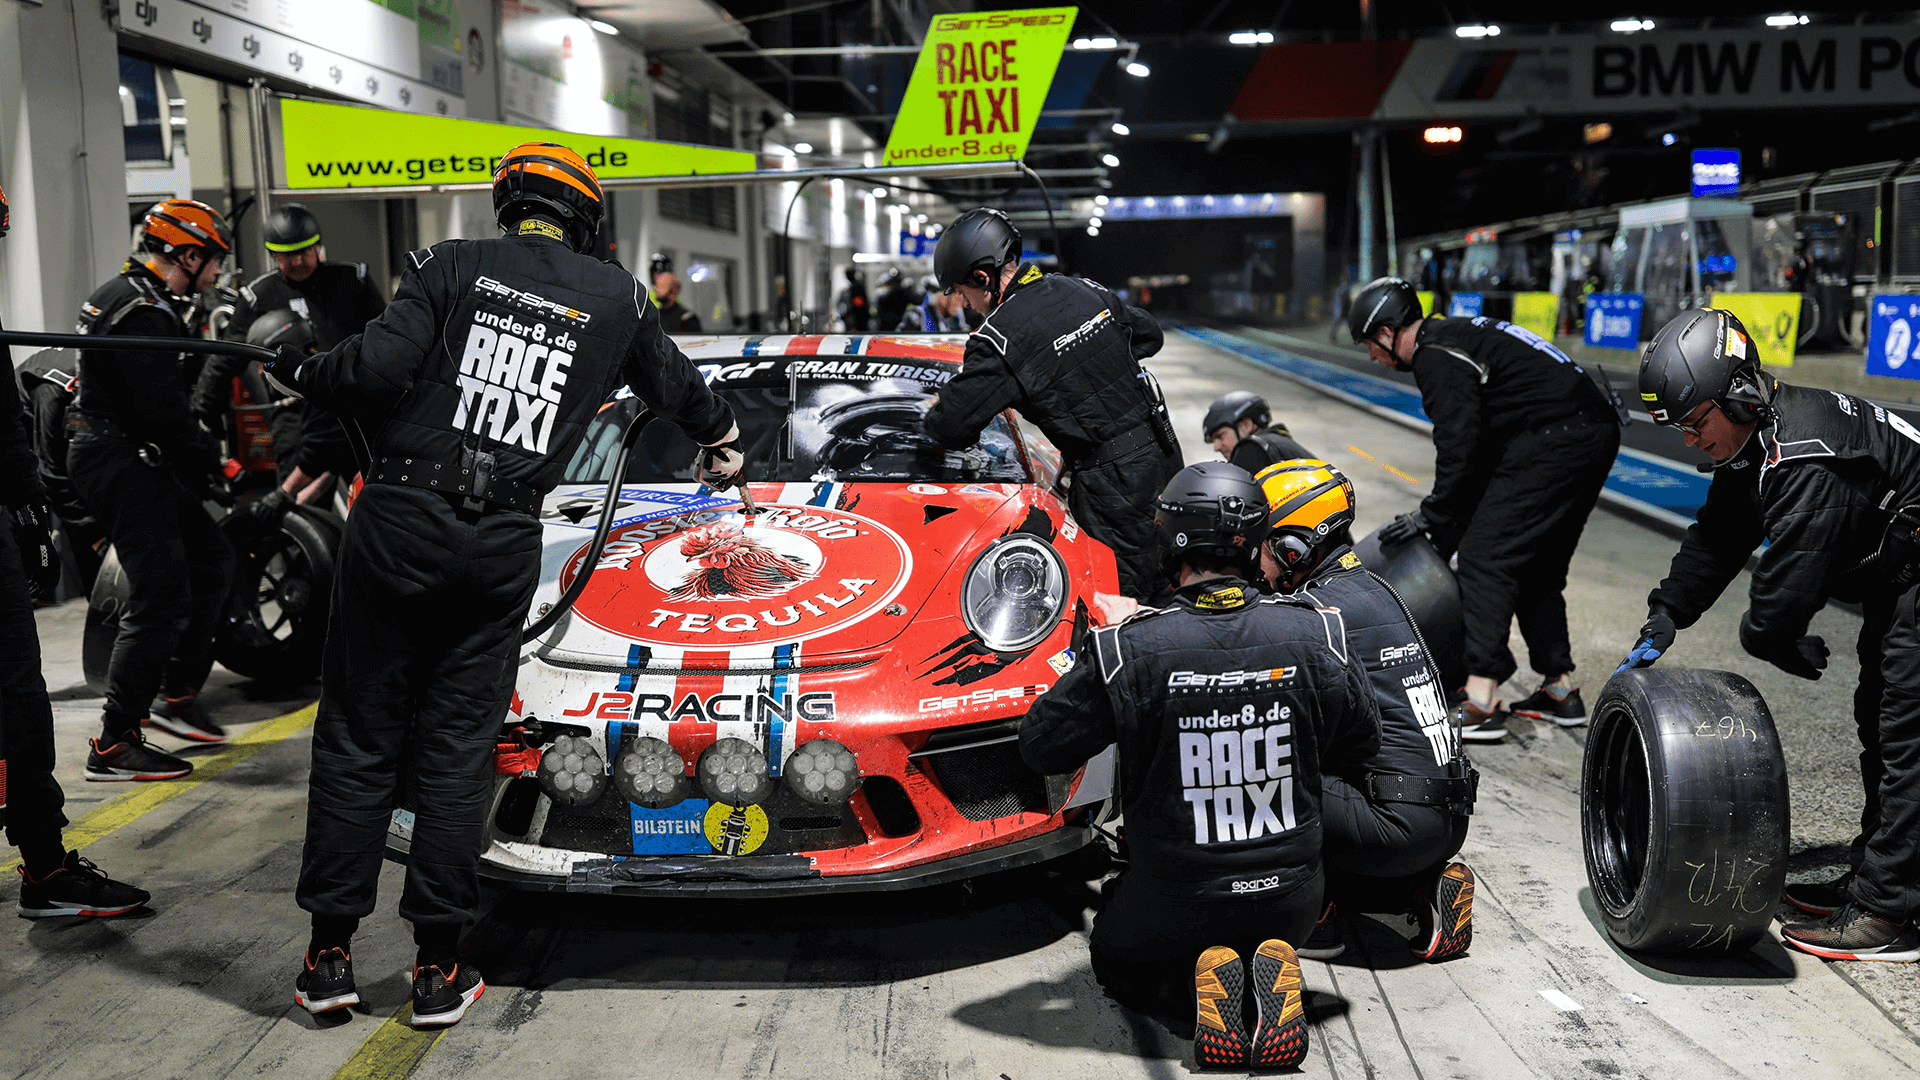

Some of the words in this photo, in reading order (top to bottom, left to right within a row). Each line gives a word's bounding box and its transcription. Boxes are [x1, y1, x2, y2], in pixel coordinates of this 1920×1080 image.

[936, 39, 1018, 85] RACE
[1592, 41, 1761, 98] BMW
[1781, 39, 1837, 92] M
[937, 87, 1020, 136] TAXI
[890, 140, 1017, 159] under8.de
[474, 310, 577, 351] under8.de
[459, 323, 574, 404] RACE
[785, 361, 860, 375] GRAN
[865, 361, 961, 385] TURISM
[849, 374, 890, 382] DRIVIN
[452, 374, 558, 455] TAXI
[610, 515, 643, 528] DAC
[645, 498, 733, 519] NORDRHEIN
[620, 489, 701, 504] URICH
[647, 576, 879, 634] TEQUILA
[921, 700, 1030, 720] performan
[1178, 701, 1291, 730] under8.de
[1178, 722, 1293, 788] RACE
[634, 818, 701, 835] BILSTEIN
[1183, 776, 1297, 845] TAXI
[1231, 875, 1280, 894] sparco
